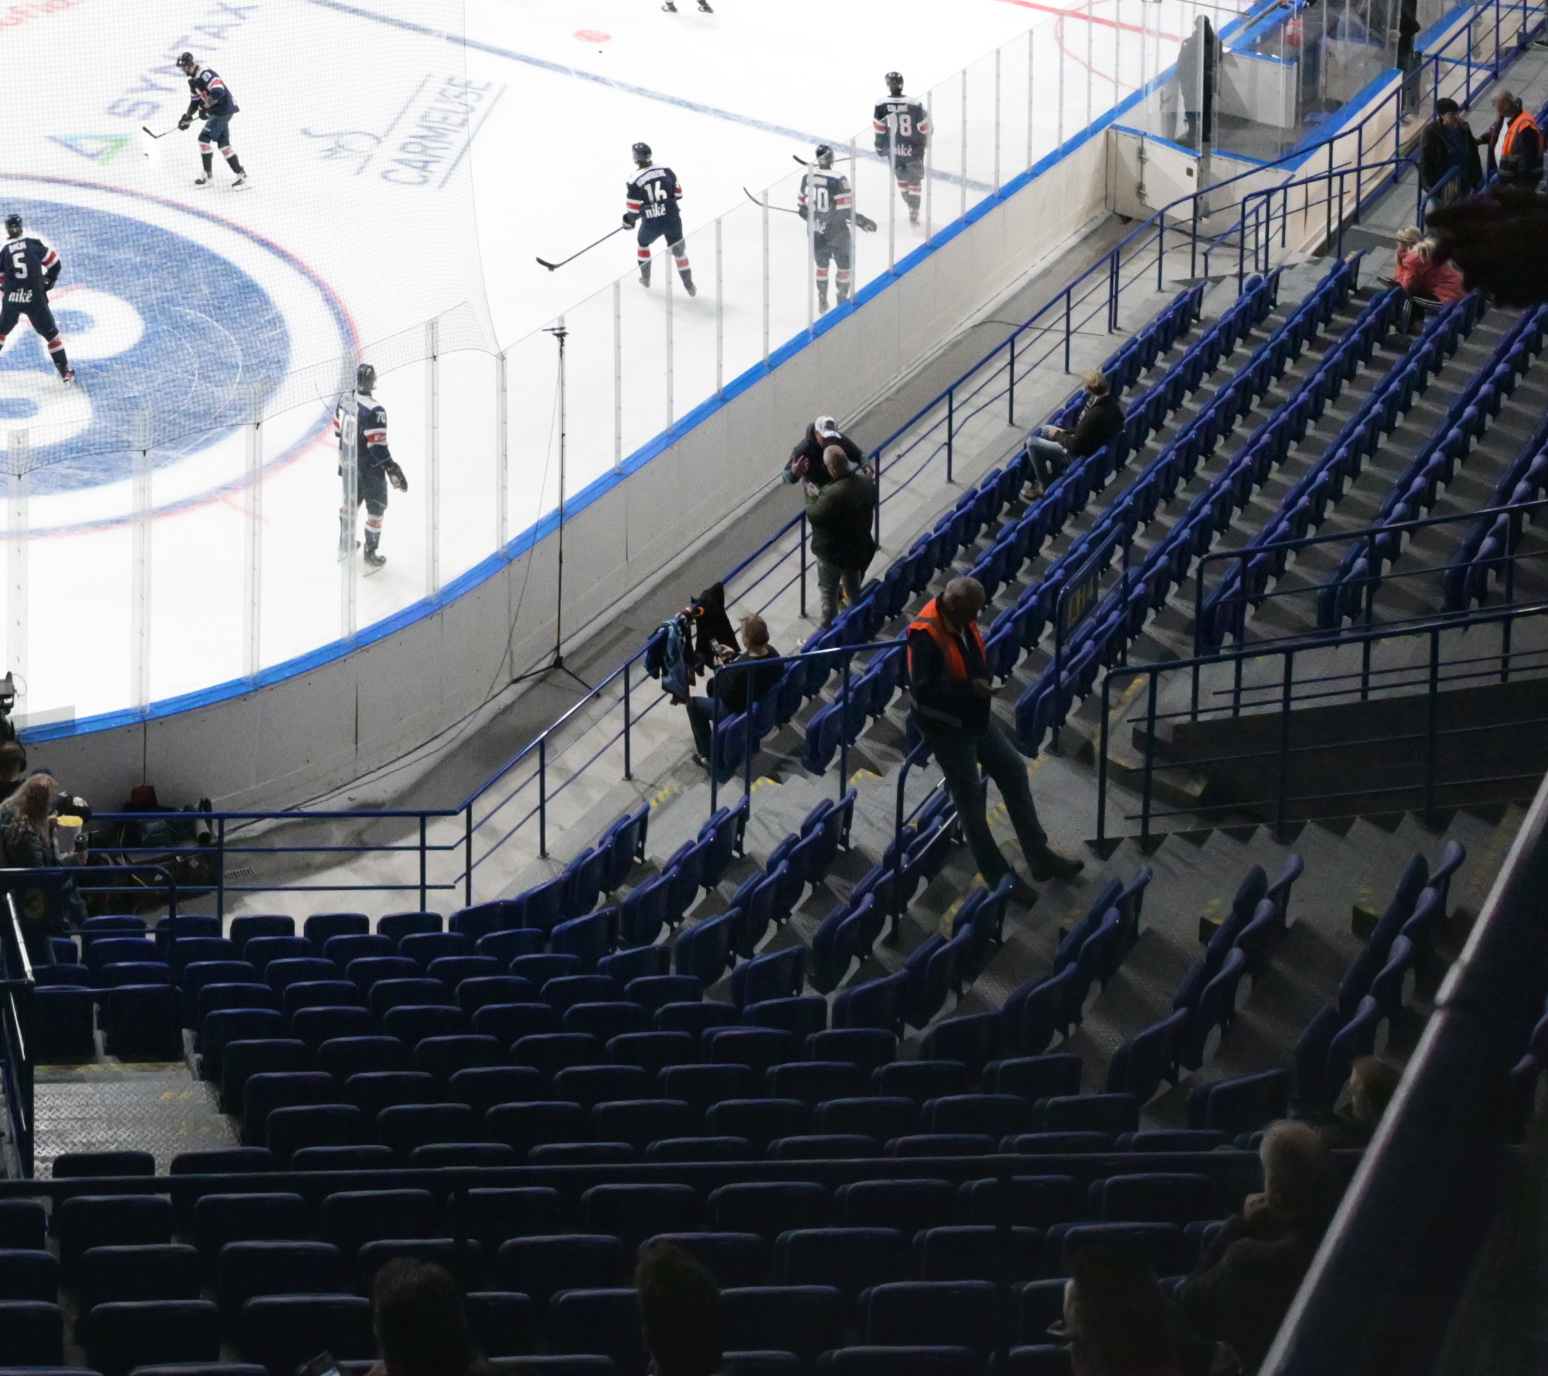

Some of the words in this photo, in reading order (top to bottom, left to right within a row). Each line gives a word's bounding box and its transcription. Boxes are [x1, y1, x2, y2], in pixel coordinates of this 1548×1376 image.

[380, 75, 493, 187] CARMEUSE
[643, 181, 668, 204] 16
[645, 203, 667, 221] niké
[11, 251, 29, 280] 5
[8, 288, 34, 304] niké
